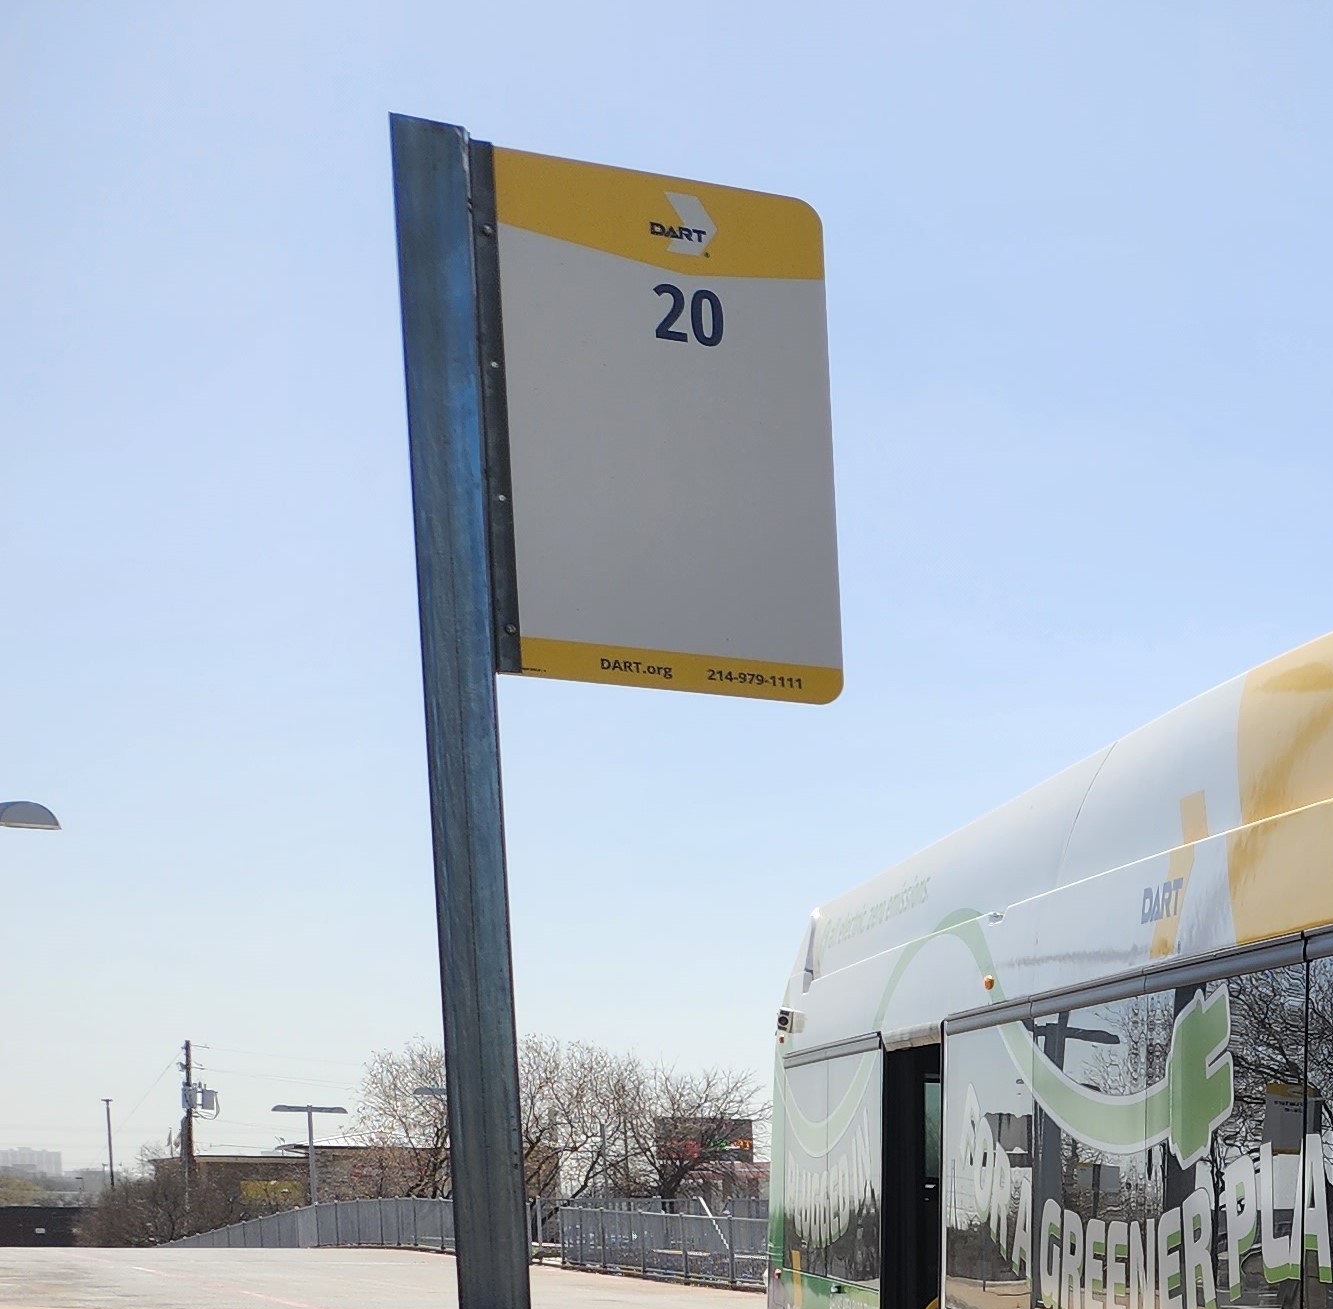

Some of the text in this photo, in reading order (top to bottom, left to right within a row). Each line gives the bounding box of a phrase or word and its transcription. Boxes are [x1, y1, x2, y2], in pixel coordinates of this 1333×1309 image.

[650, 222, 707, 243] DART
[652, 283, 724, 347] 20
[600, 658, 803, 690] DART.org 214-979-1111
[1141, 877, 1184, 924] DART
